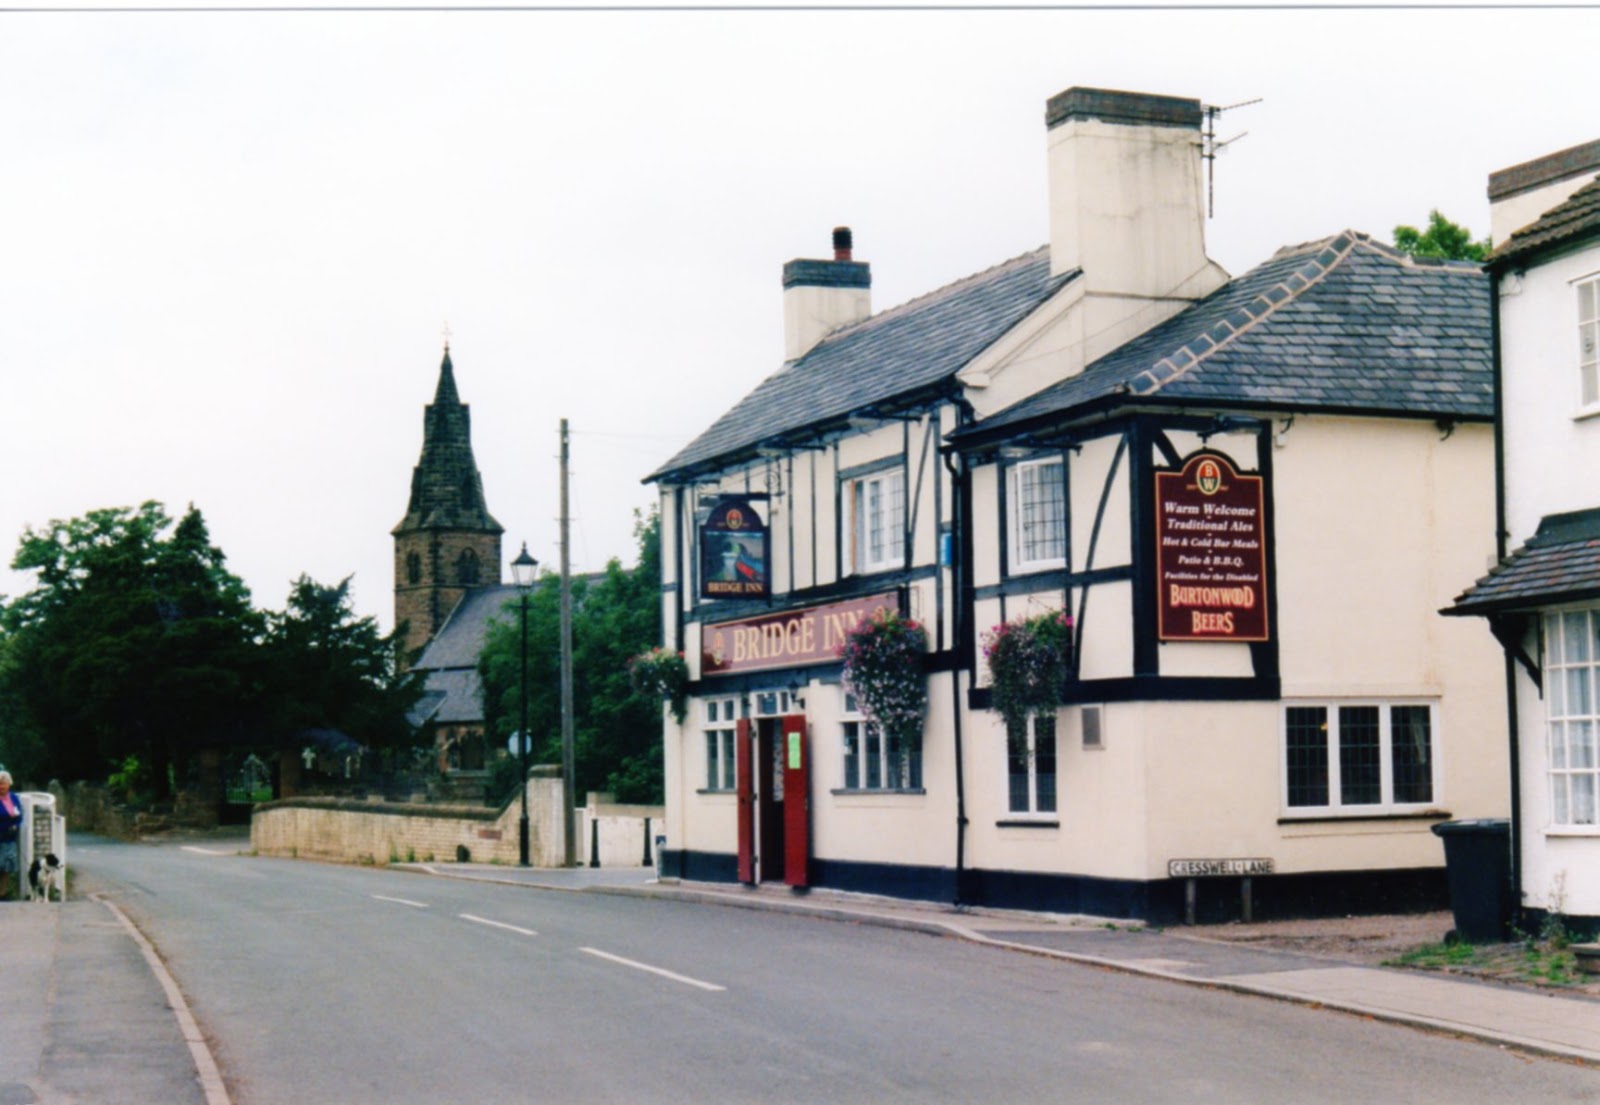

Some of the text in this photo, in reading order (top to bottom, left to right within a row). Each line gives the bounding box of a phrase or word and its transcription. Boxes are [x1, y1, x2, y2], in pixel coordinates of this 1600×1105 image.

[1164, 501, 1256, 516] Warm Welcome
[1167, 518, 1253, 532] Traditional Ales
[1163, 537, 1259, 549] Hot & Cold Bar Meals
[1178, 555, 1201, 564] Patio
[1203, 556, 1211, 565] &
[1164, 572, 1198, 580] Facilities
[1226, 573, 1259, 582] Disabled
[708, 582, 763, 593] BRIDGE INN
[1170, 584, 1255, 609] BURTONWOOD
[1192, 611, 1234, 634] BEERS
[732, 617, 815, 662] BRIDGE
[1243, 861, 1272, 874] LANE
